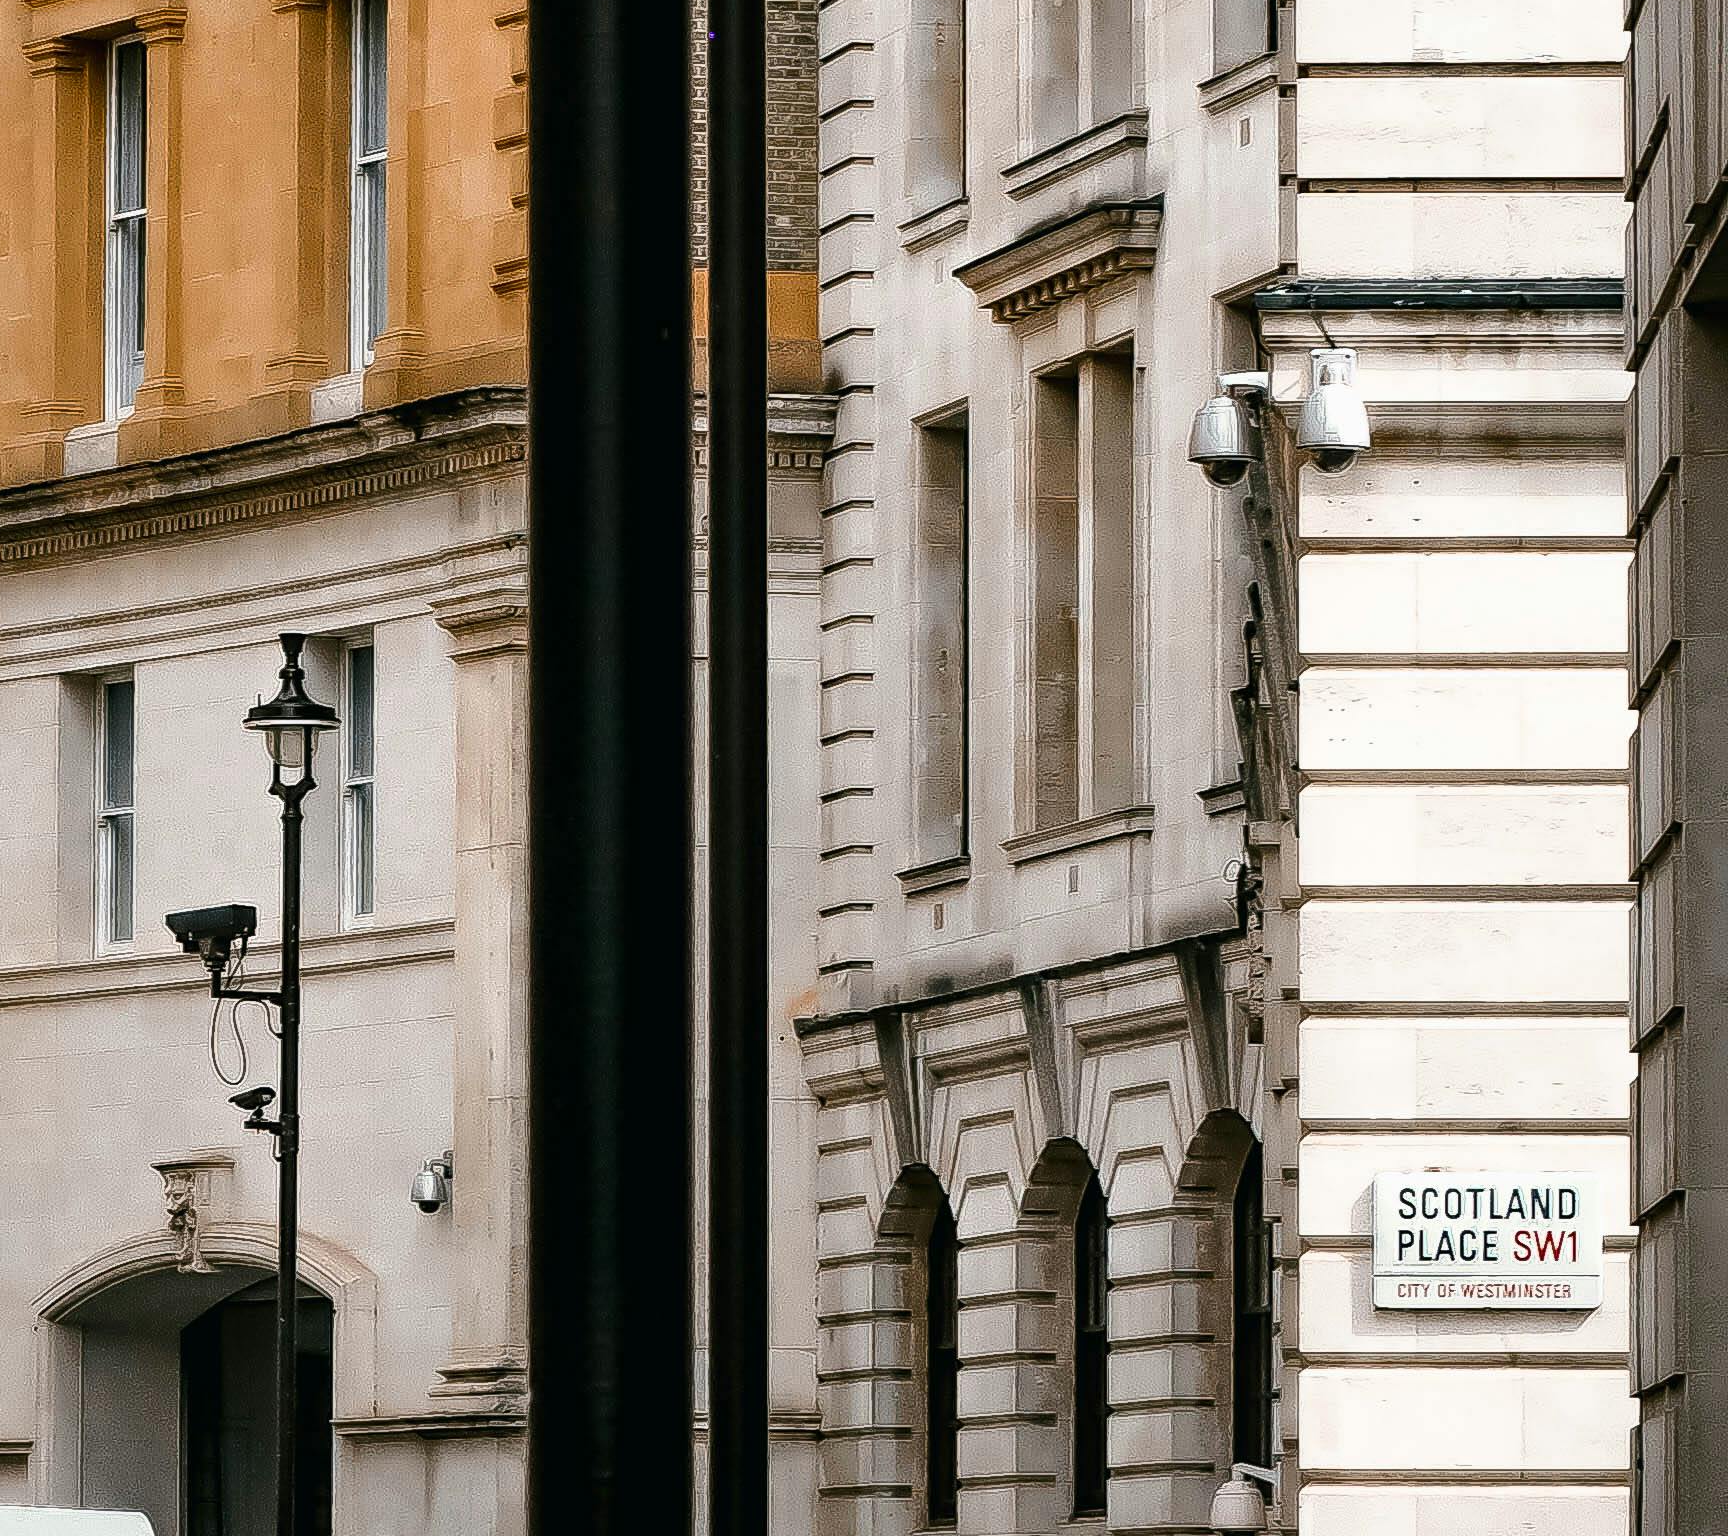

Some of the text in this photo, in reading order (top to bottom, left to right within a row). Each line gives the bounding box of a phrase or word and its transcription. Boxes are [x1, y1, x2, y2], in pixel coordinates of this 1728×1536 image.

[1398, 1187, 1578, 1220] SCOTLAND
[1398, 1229, 1578, 1262] PLACE SW1
[1397, 1283, 1572, 1299] CITY OF WESTMINSTER
